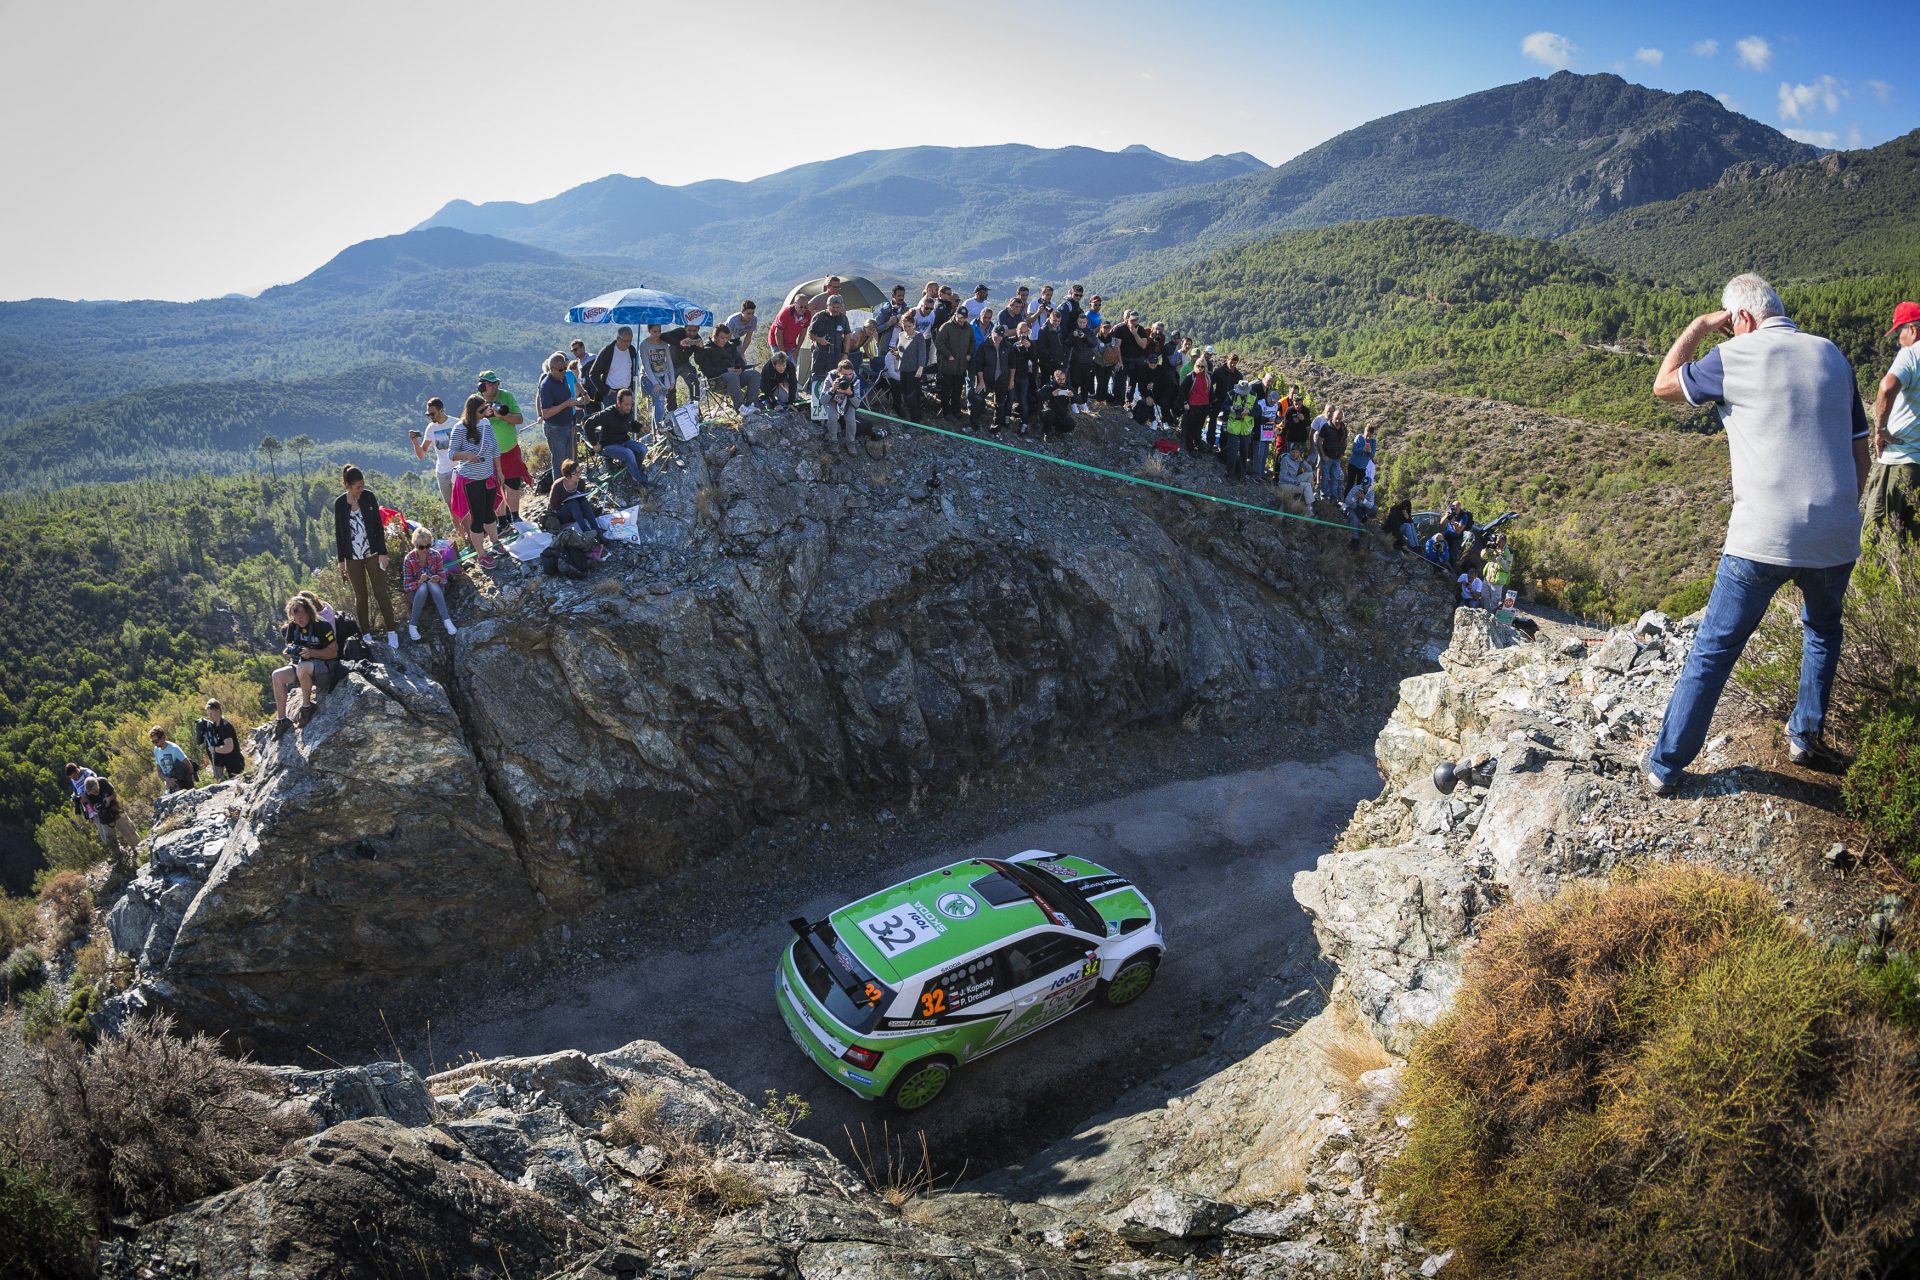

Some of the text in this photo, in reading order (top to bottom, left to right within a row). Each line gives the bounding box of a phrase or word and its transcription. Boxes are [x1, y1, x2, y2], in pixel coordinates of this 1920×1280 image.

[908, 912, 929, 930] IGOL
[868, 914, 916, 951] 32
[1084, 960, 1098, 976] 32
[960, 976, 994, 997] J. Kopecký
[1051, 970, 1079, 990] IGOL
[921, 988, 946, 1017] 32
[960, 988, 992, 1006] P. Dresler
[911, 1019, 938, 1027] EDGE
